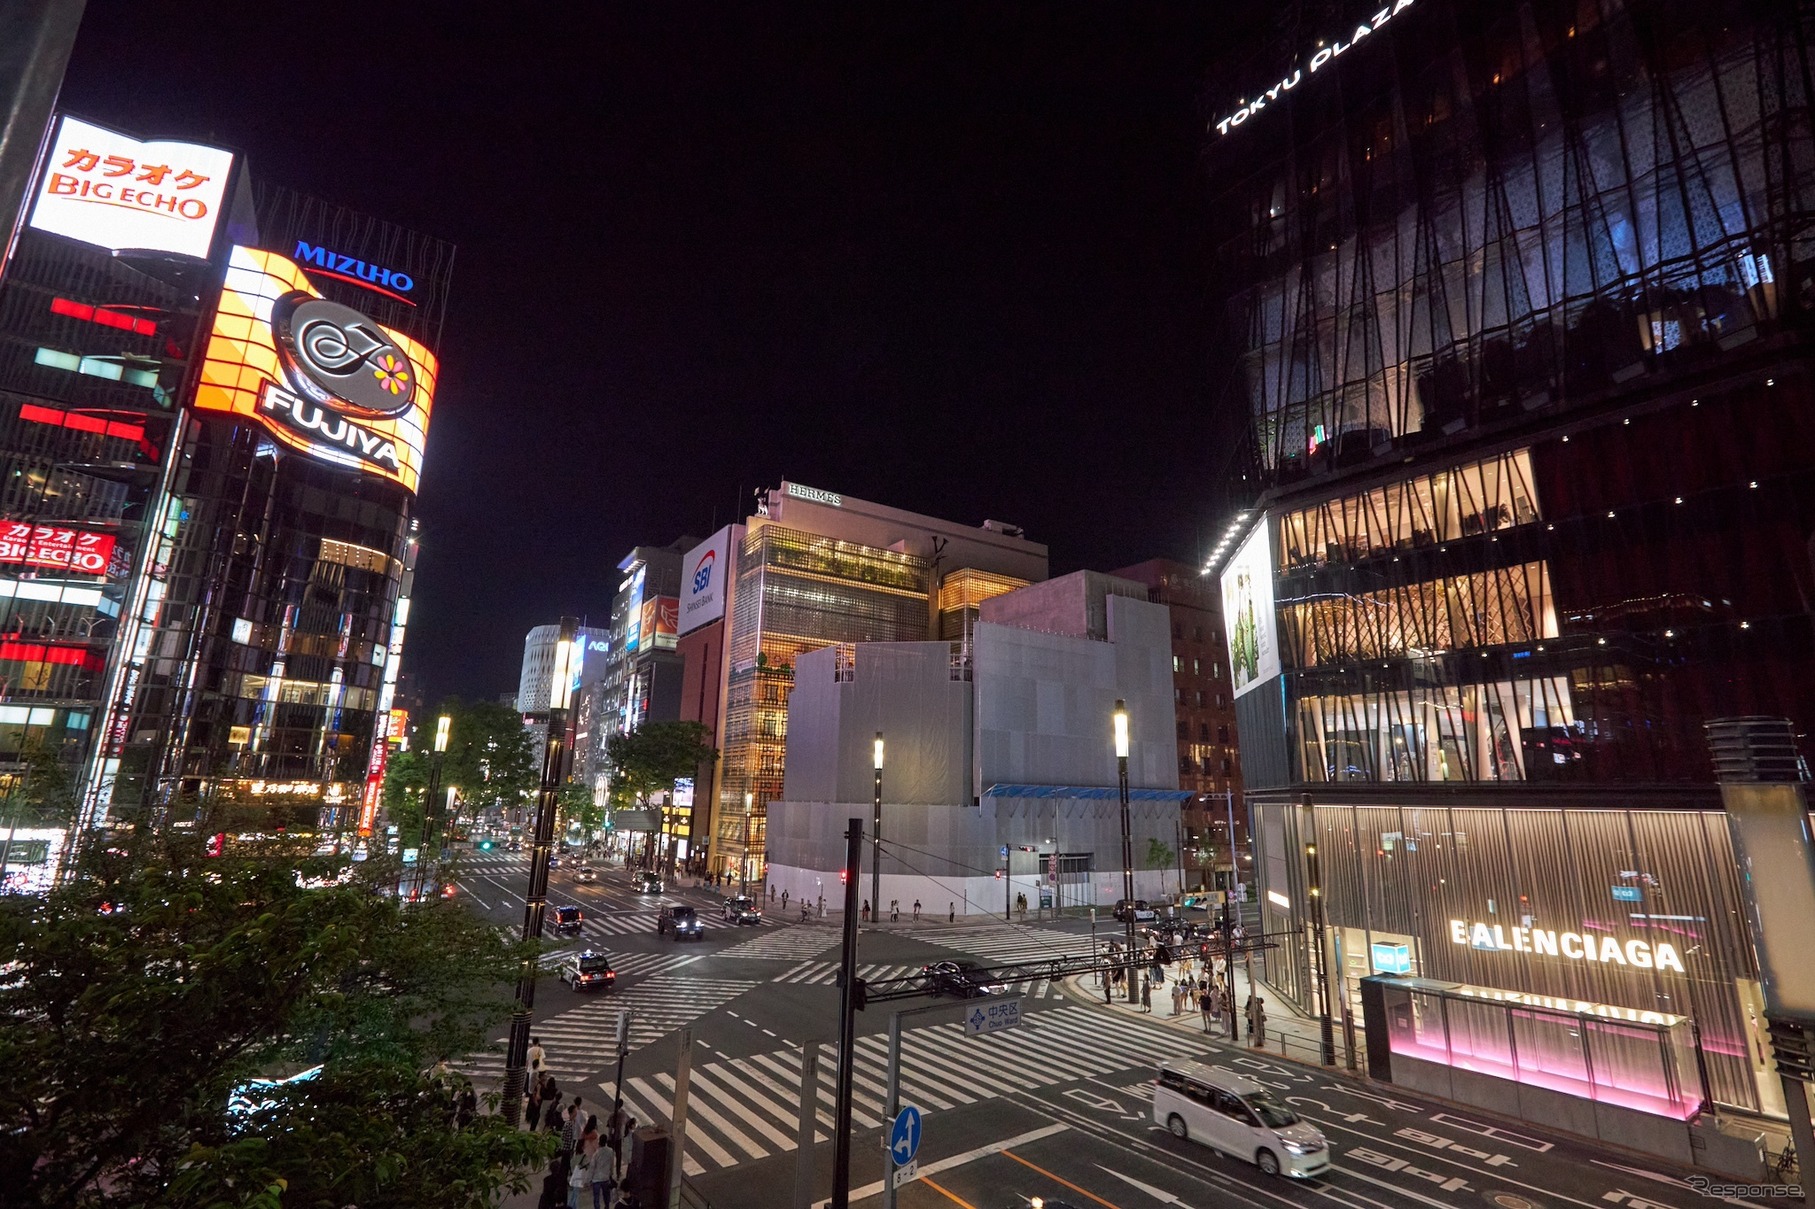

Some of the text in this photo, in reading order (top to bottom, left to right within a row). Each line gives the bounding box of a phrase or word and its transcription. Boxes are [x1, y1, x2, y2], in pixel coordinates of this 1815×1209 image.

[1216, 0, 1414, 134] TOKYU PLAZA
[62, 149, 210, 190] カラオケ
[47, 172, 208, 219] BIG ECHO
[294, 240, 414, 292] MIZUHO
[264, 384, 401, 469] FUJIYA
[8, 524, 102, 546] カラオケ
[39, 547, 104, 569] ECHO
[693, 564, 712, 594] SBI
[988, 1002, 1018, 1018] 中央区
[988, 1016, 1018, 1028] Chuo Ward
